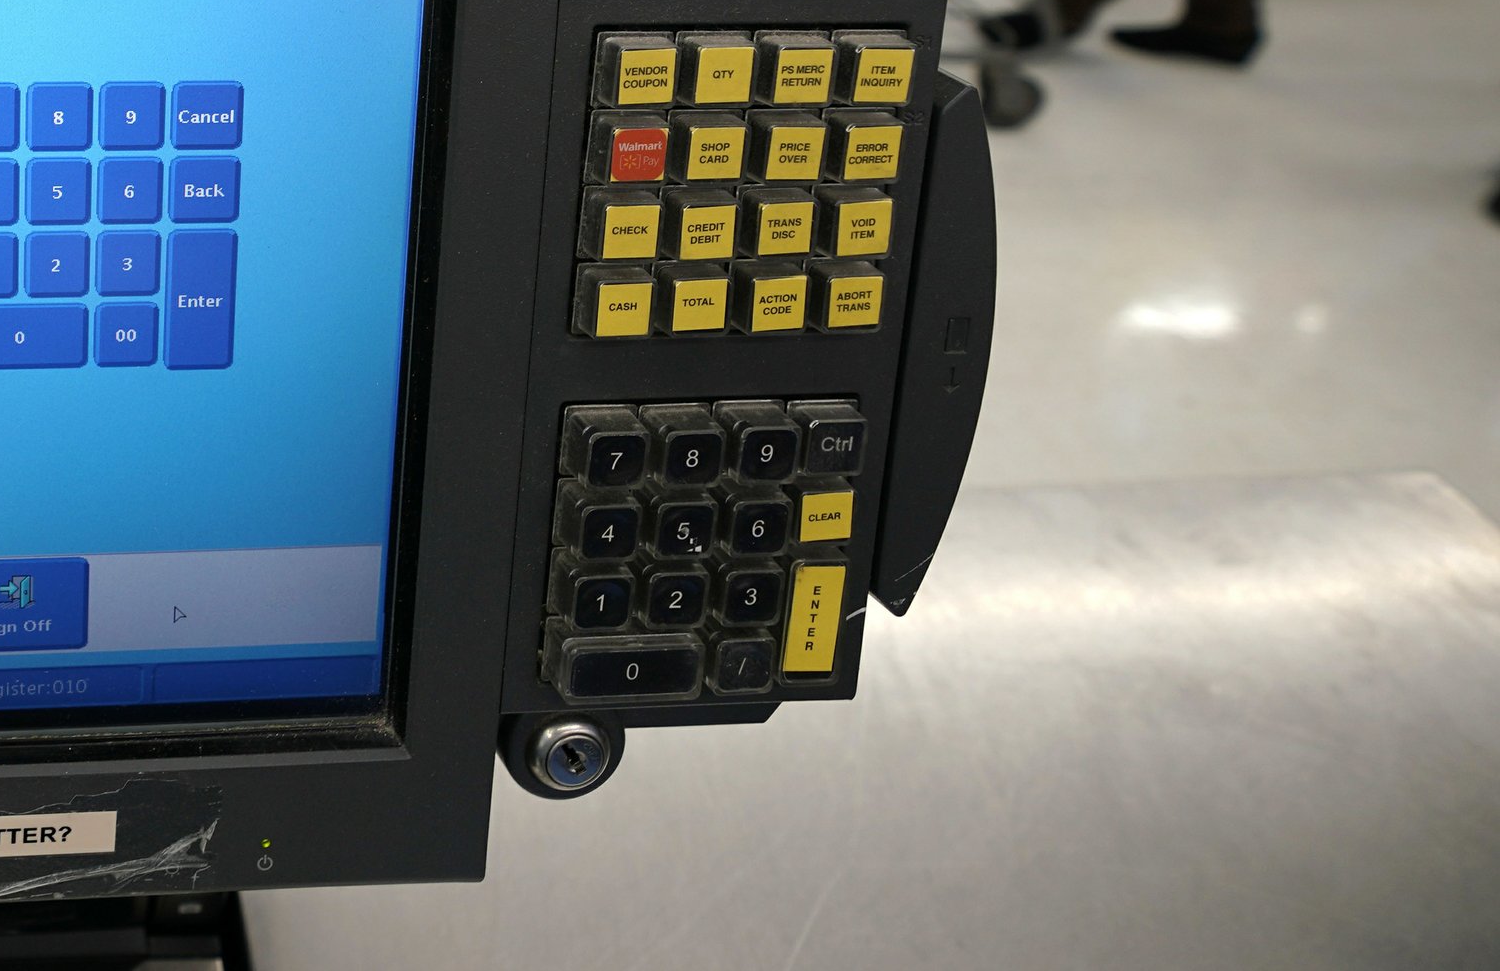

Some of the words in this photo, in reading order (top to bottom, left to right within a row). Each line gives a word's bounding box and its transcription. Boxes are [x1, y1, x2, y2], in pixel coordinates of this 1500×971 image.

[624, 65, 668, 77] VENDOR
[712, 69, 735, 79] QTY
[781, 65, 795, 75] PS
[796, 64, 825, 74] MERC
[870, 65, 896, 75] ITEM
[622, 78, 668, 89] COUPON
[781, 77, 822, 87] RETURN
[860, 77, 903, 87] INQUIRY
[53, 111, 64, 125] 8
[125, 110, 137, 125] 9
[178, 109, 235, 124] Cancel
[618, 140, 663, 152] Walmart
[700, 142, 731, 152] SHOP
[779, 142, 811, 152] PRICE
[855, 142, 889, 153] ERROR
[642, 155, 660, 168] Pay
[699, 154, 730, 164] CARD
[778, 154, 808, 164] OVER
[846, 153, 894, 165] CORRECT
[52, 185, 63, 200] 5
[124, 184, 135, 199] 6
[184, 183, 225, 198] Back
[687, 222, 726, 233] CREDIT
[767, 217, 802, 228] TRANS
[851, 217, 876, 228] VOID
[611, 225, 649, 236] CHECK
[771, 229, 796, 240] DISC
[850, 229, 875, 240] ITEM
[690, 234, 722, 245] DEBIT
[51, 258, 61, 273] 2
[122, 257, 133, 271] 3
[178, 294, 224, 308] Enter
[682, 297, 715, 307] TOTAL
[758, 293, 798, 305] ACTION
[836, 290, 873, 303] ABORT
[608, 302, 638, 312] CASH
[762, 305, 792, 316] CODE
[836, 301, 871, 313] TRANS
[14, 331, 25, 345] 0
[115, 328, 137, 342] 00
[821, 436, 854, 452] Ctrl
[685, 449, 699, 468] 8
[760, 444, 774, 463] 9
[610, 452, 624, 470] 7
[808, 511, 841, 523] CLEAR
[601, 524, 615, 543] 4
[677, 522, 690, 540] 5
[751, 519, 765, 538] 6
[668, 590, 683, 609] 2
[744, 587, 757, 606] 3
[596, 594, 605, 612] 1
[804, 585, 822, 651] ENTER
[23, 619, 52, 632] Off
[626, 662, 639, 681] 0
